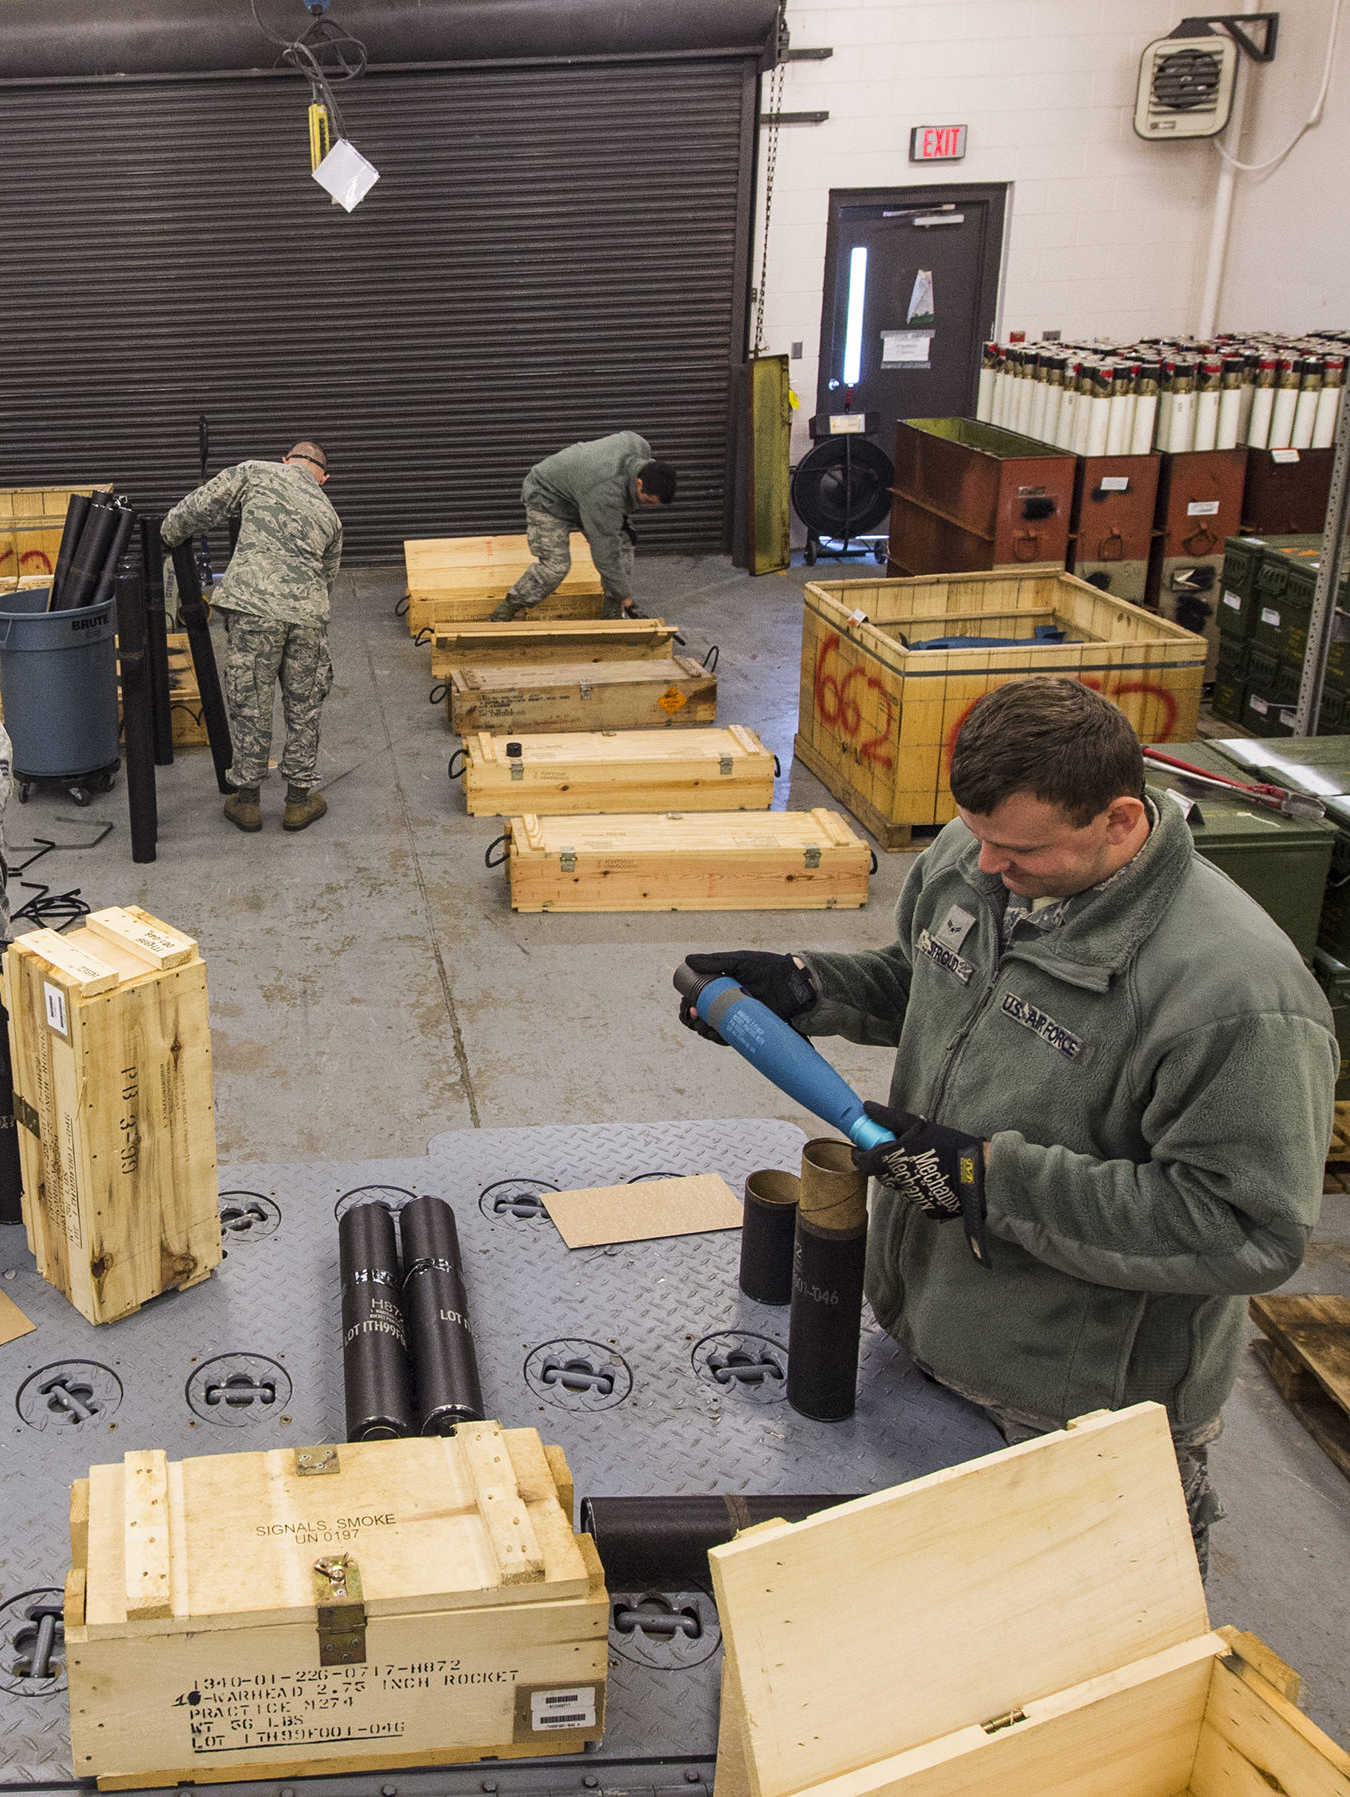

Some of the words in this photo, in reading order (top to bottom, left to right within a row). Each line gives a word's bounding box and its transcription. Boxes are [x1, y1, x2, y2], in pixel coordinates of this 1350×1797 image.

[923, 127, 961, 157] EXIT
[71, 614, 109, 631] BRUTE
[928, 941, 958, 973] STROUD
[1002, 994, 1023, 1020] U.S.
[1024, 1009, 1048, 1032] AIR
[1043, 1024, 1078, 1058] FORCE
[121, 1066, 138, 1100] PB
[120, 1114, 138, 1174] 3-99
[882, 1147, 936, 1211] Mechanix
[908, 1148, 962, 1213] Mechanix
[440, 1309, 462, 1324] LOT
[336, 1513, 396, 1529] SMOKE
[295, 1533, 318, 1545] UN
[323, 1528, 360, 1542] 0197
[317, 1680, 366, 1697] 2.75
[382, 1675, 430, 1692] INCH
[444, 1670, 519, 1686] ROCKET
[190, 1702, 292, 1720] PRACTICE
[231, 1719, 254, 1732] 56
[268, 1714, 304, 1729] LBS
[192, 1734, 226, 1750] LOT
